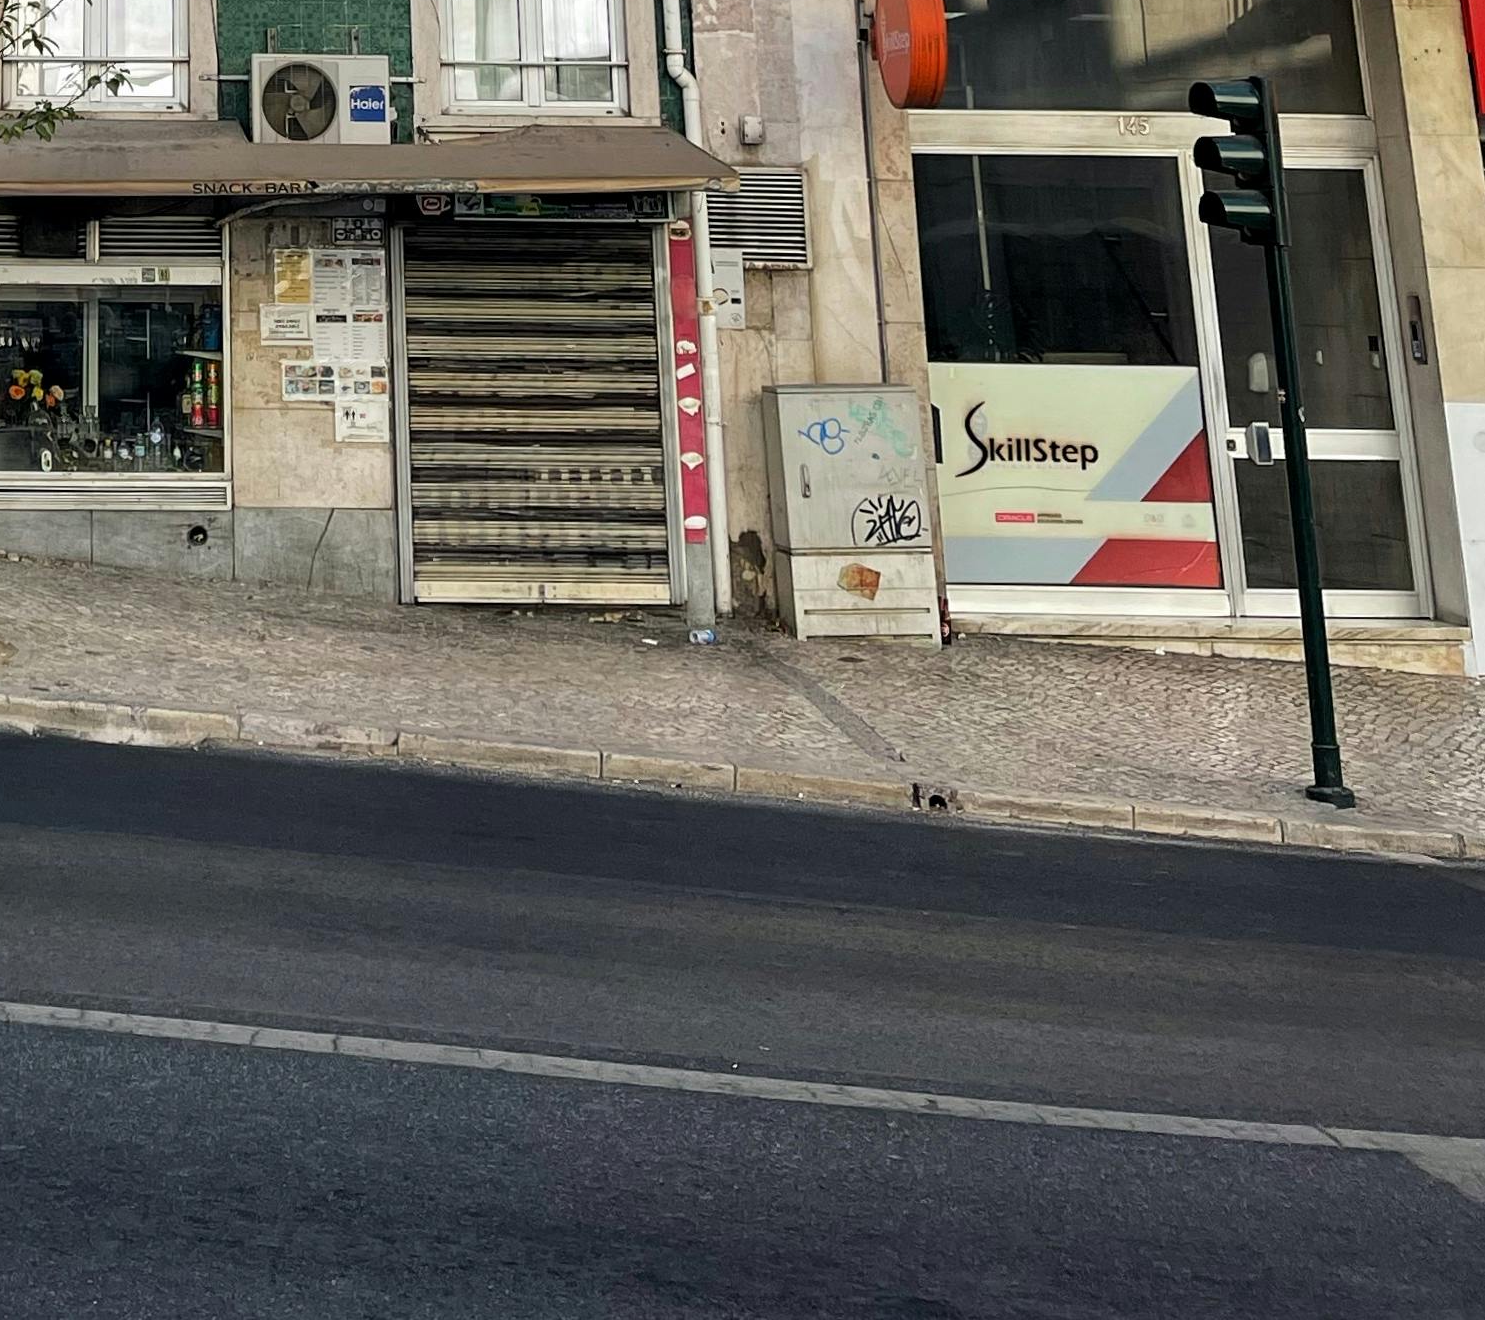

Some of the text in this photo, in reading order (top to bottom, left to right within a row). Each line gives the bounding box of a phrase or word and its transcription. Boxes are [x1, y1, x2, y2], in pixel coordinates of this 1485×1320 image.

[351, 97, 384, 110] Haier
[1117, 116, 1150, 136] 145
[954, 400, 1100, 478] SkillStep
